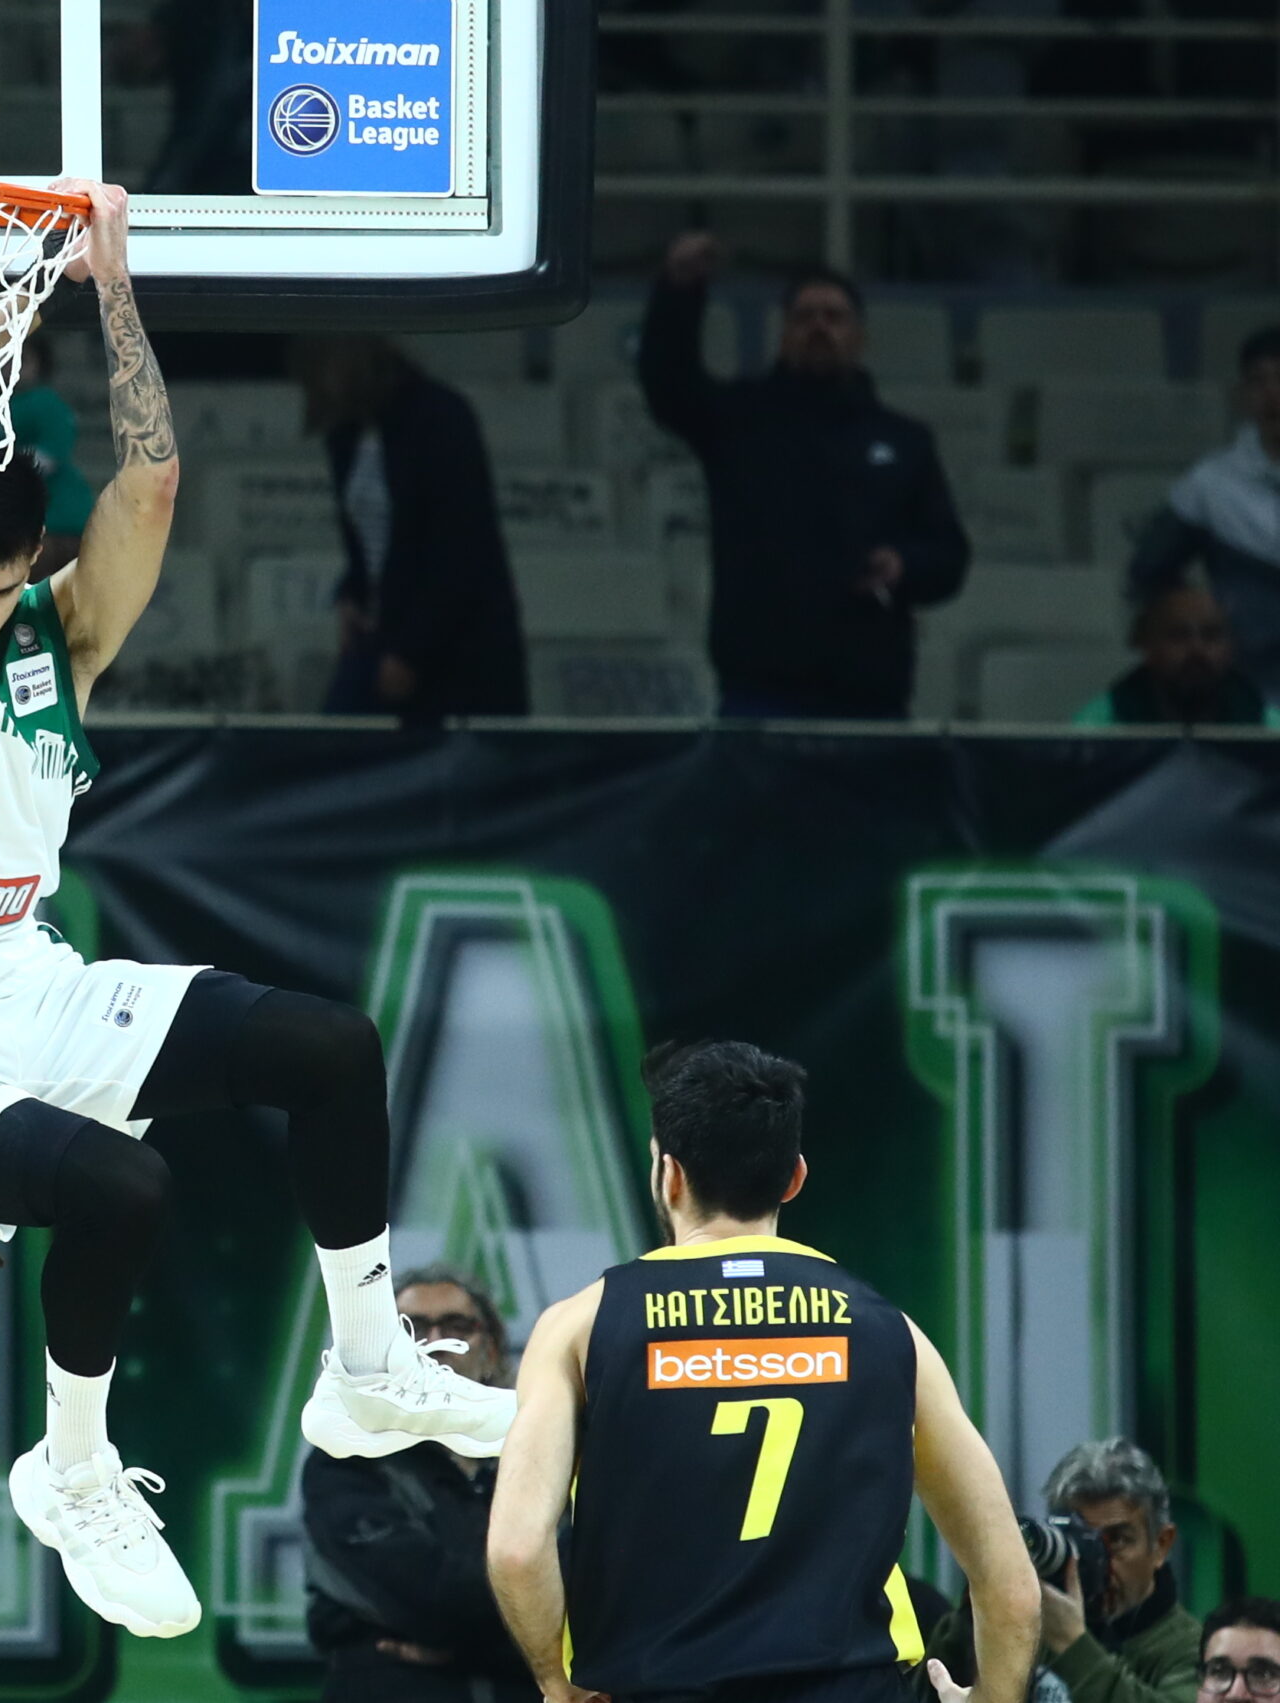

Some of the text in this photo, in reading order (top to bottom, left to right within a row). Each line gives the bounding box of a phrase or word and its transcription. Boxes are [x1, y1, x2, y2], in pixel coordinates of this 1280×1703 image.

[269, 30, 440, 66] Stoiximan
[348, 94, 440, 120] Basket
[348, 121, 440, 151] League
[11, 665, 50, 683] Stoiximan
[32, 679, 52, 691] Basket
[32, 687, 53, 698] League
[645, 1286, 852, 1328] ΚΑΤΣΙΒΕΛΗΣ
[654, 1348, 841, 1382] betsson
[710, 1397, 805, 1541] 7
